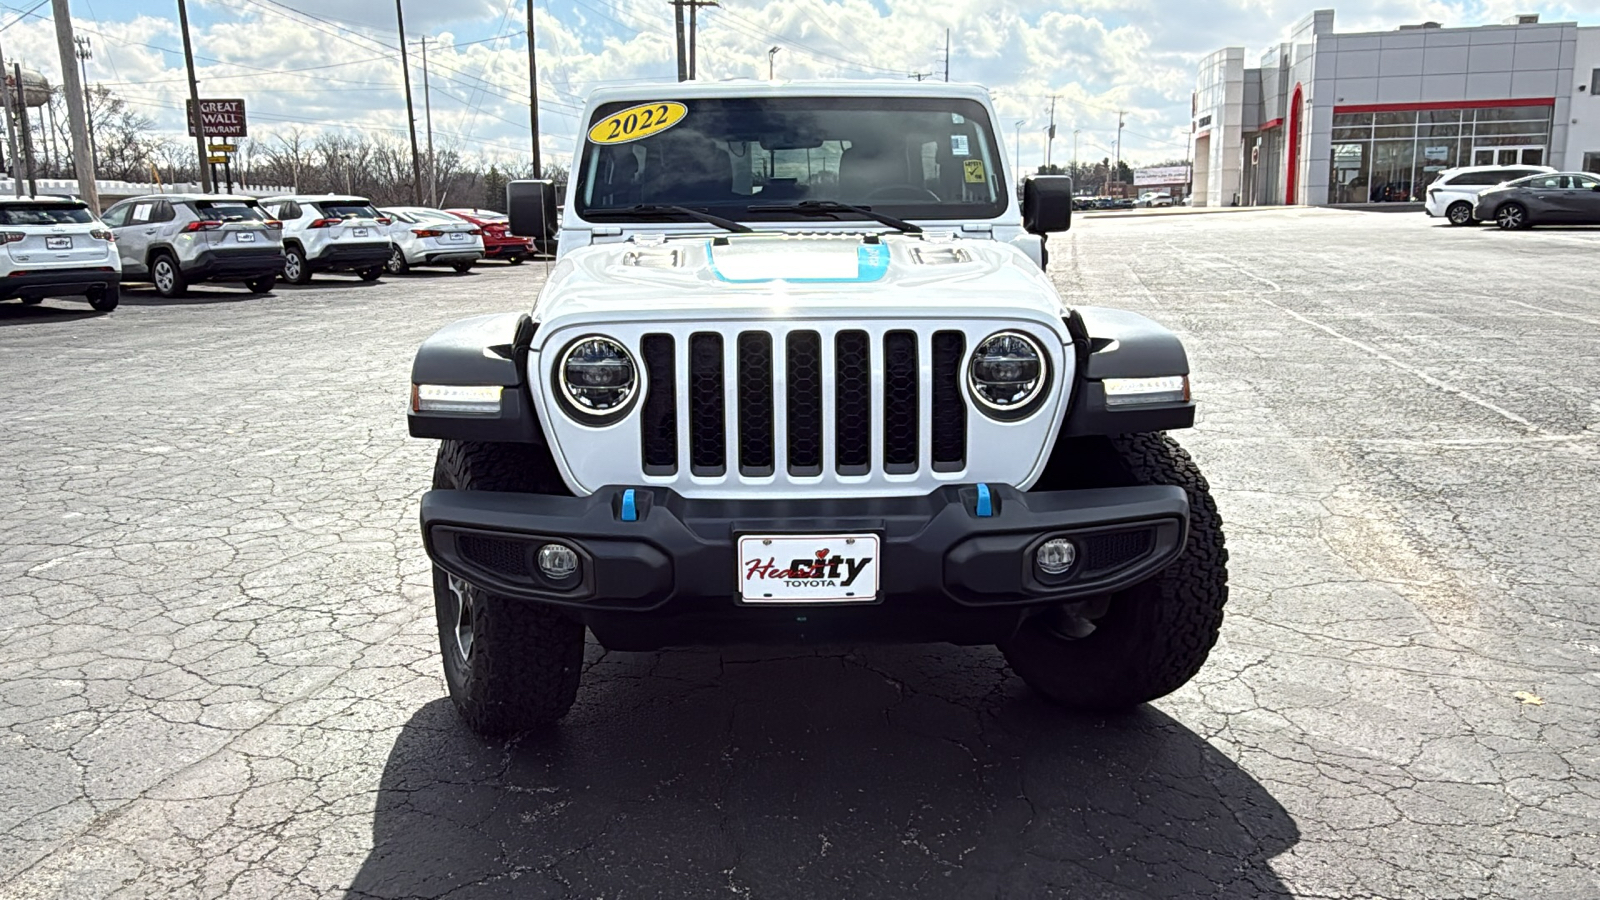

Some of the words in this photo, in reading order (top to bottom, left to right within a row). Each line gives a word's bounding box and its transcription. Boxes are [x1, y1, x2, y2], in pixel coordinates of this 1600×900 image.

[201, 102, 238, 113] GREAT
[202, 113, 238, 124] WALL
[606, 105, 669, 140] 2022
[788, 548, 873, 587] city
[784, 580, 836, 588] TOYOTA
